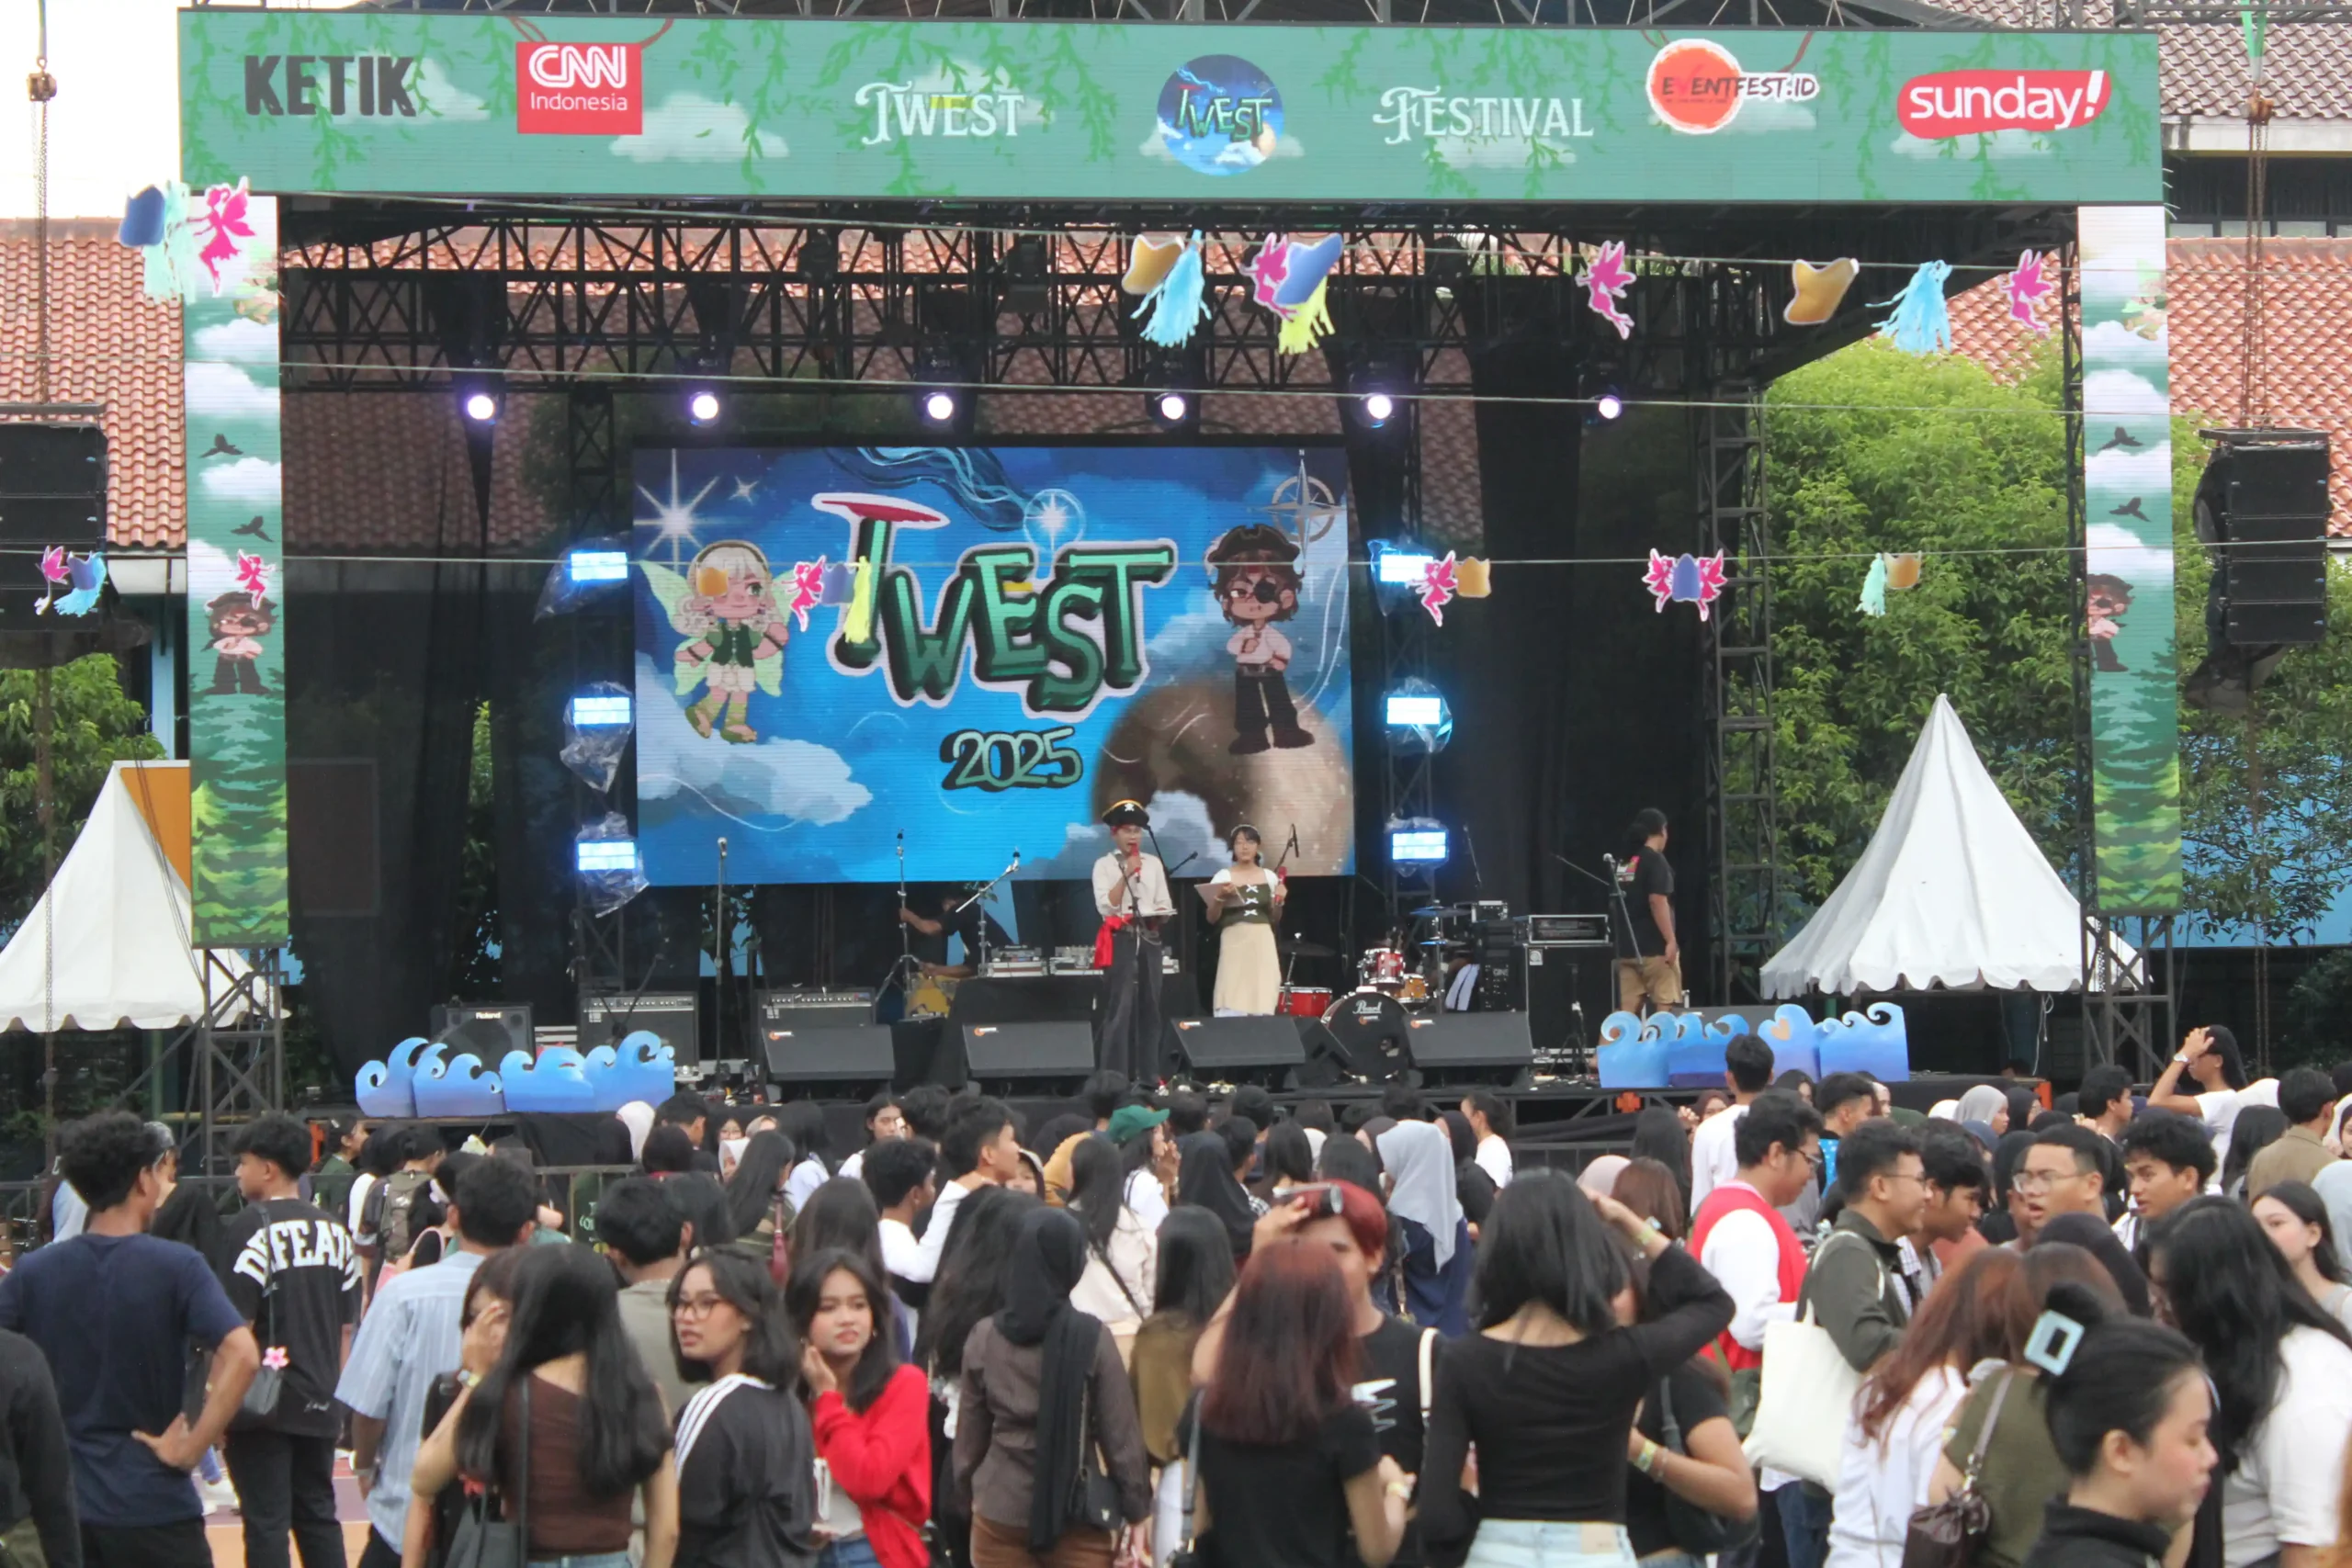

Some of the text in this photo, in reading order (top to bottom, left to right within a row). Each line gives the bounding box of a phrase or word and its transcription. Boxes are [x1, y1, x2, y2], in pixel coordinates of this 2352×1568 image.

[244, 55, 416, 117] KETIK
[528, 45, 627, 88] CNN
[530, 92, 628, 110] Indonesia
[854, 80, 1024, 145] TWEST
[1174, 84, 1273, 144] TWEST
[1372, 85, 1595, 145] FESTIVAL
[1909, 70, 2105, 130] sunday!
[810, 491, 1179, 721] TWEST
[940, 725, 1084, 793] 2025
